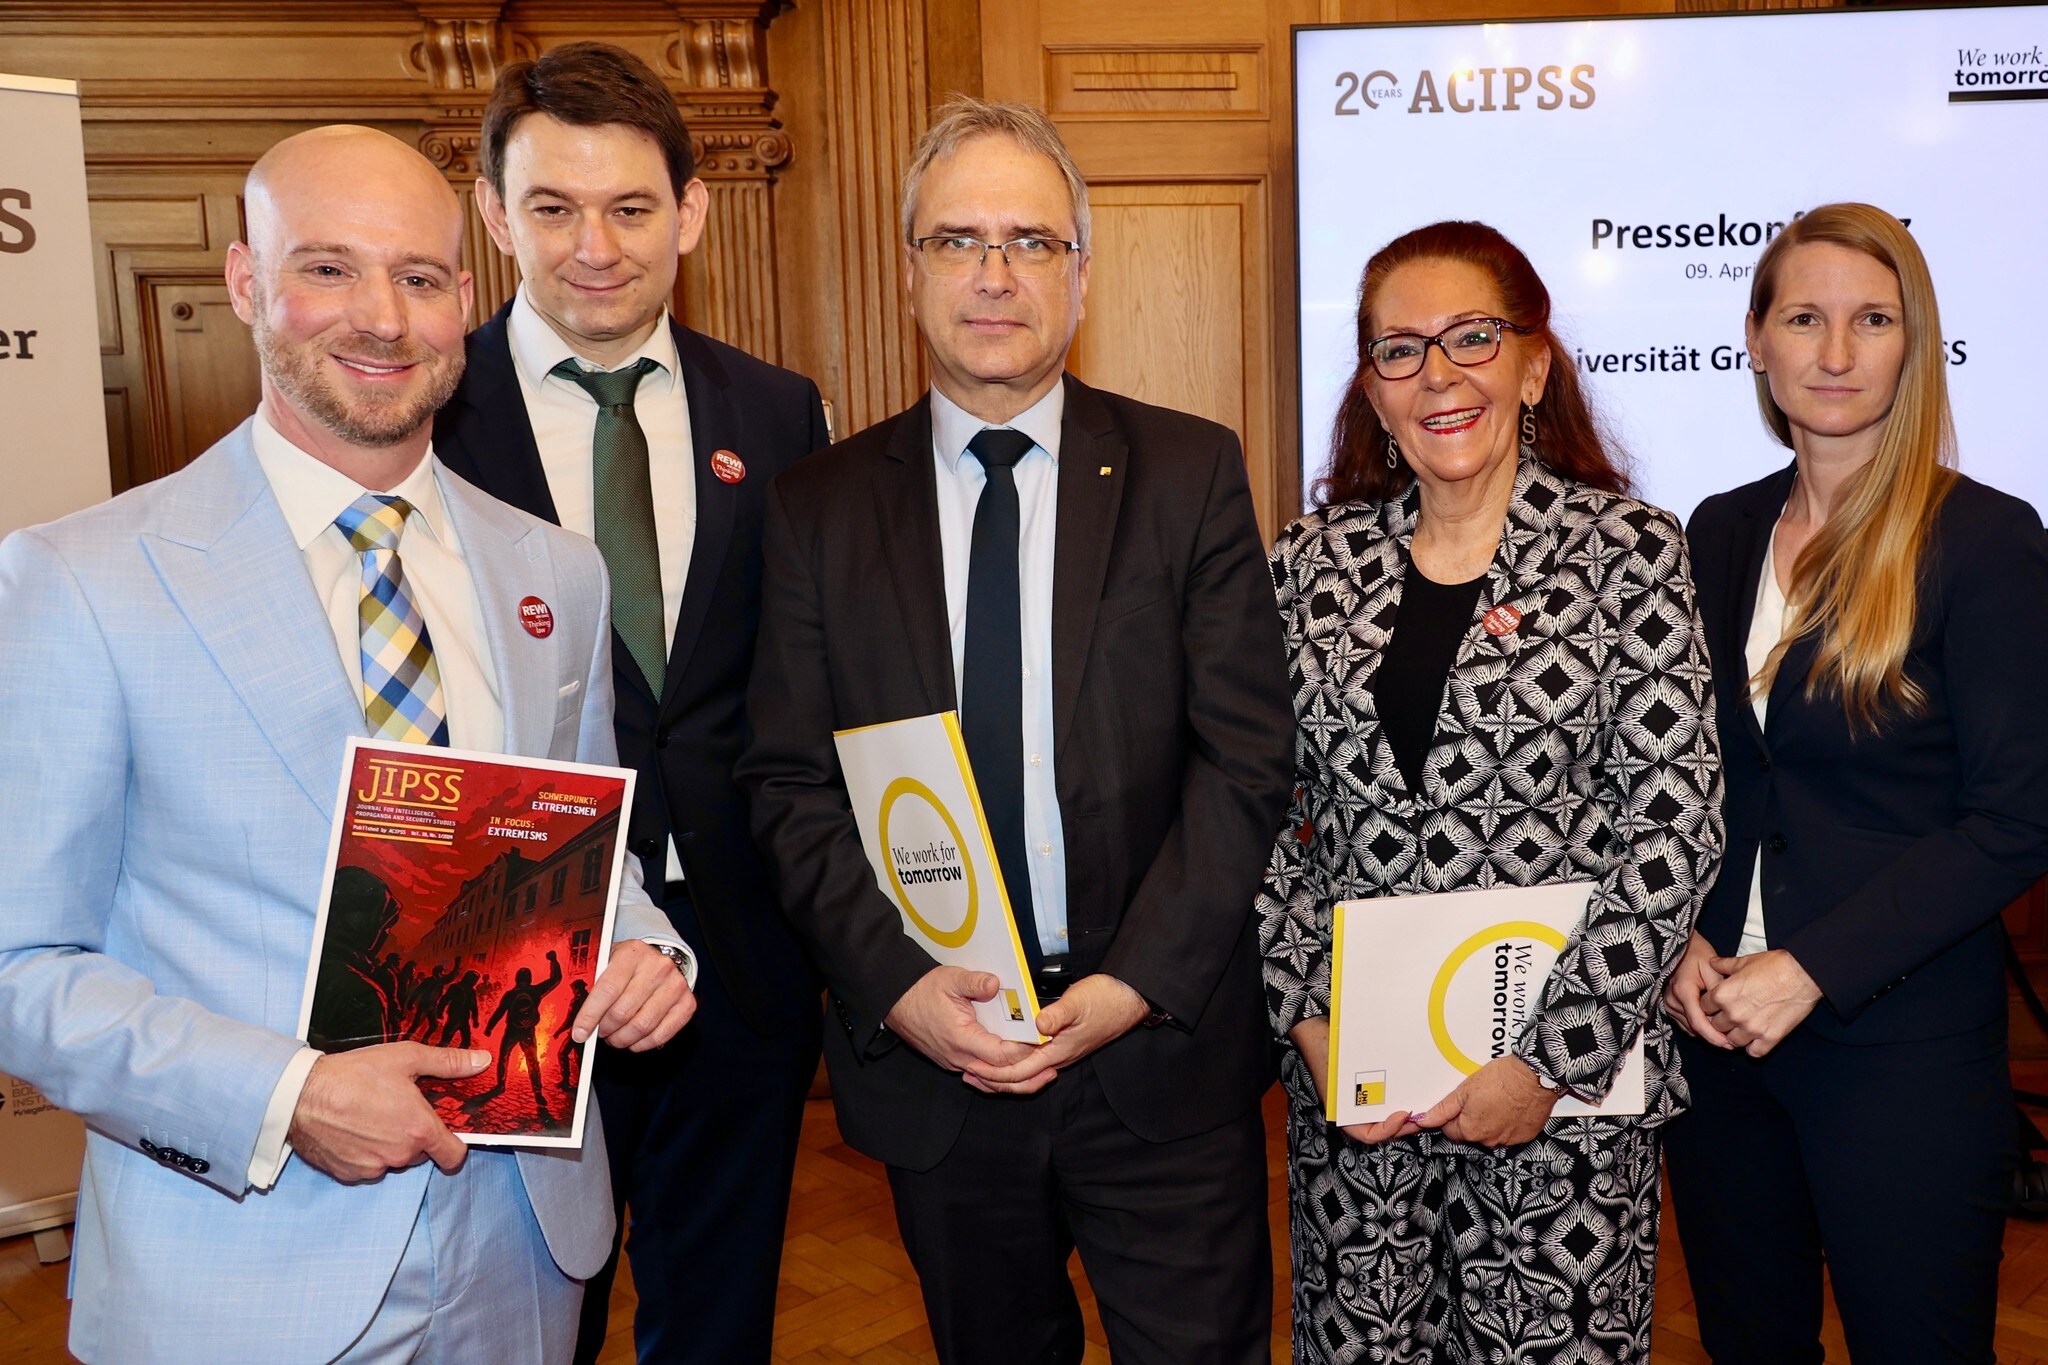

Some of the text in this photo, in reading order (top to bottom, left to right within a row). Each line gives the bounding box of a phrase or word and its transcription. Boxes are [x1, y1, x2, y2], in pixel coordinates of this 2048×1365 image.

[1957, 45, 2043, 67] We work
[1954, 69, 2048, 86] tomorro
[1371, 88, 1403, 99] YEARS
[1408, 64, 1596, 114] ACIPSS
[1685, 261, 1757, 282] 09. Apri
[1576, 345, 1701, 373] iversität
[716, 453, 743, 469] REWI
[522, 603, 548, 616] REWI
[1495, 606, 1519, 626] REWI
[358, 765, 462, 803] JIPSS
[356, 803, 382, 812] JOURNAL
[538, 791, 597, 806] SCHWERPUNKT:
[531, 801, 597, 817] EXTREMISMEN
[355, 811, 392, 820] PROPAGANDA
[405, 815, 432, 824] SECURITY
[433, 819, 456, 827] STUDIES
[490, 816, 535, 829] IN FOCUS:
[487, 826, 548, 841] EXTREMISMS
[892, 841, 956, 866] We work for
[898, 866, 962, 885] tomorrow
[1514, 944, 1533, 975] We
[1491, 943, 1512, 1059] tomorrow
[1511, 981, 1528, 1029] work
